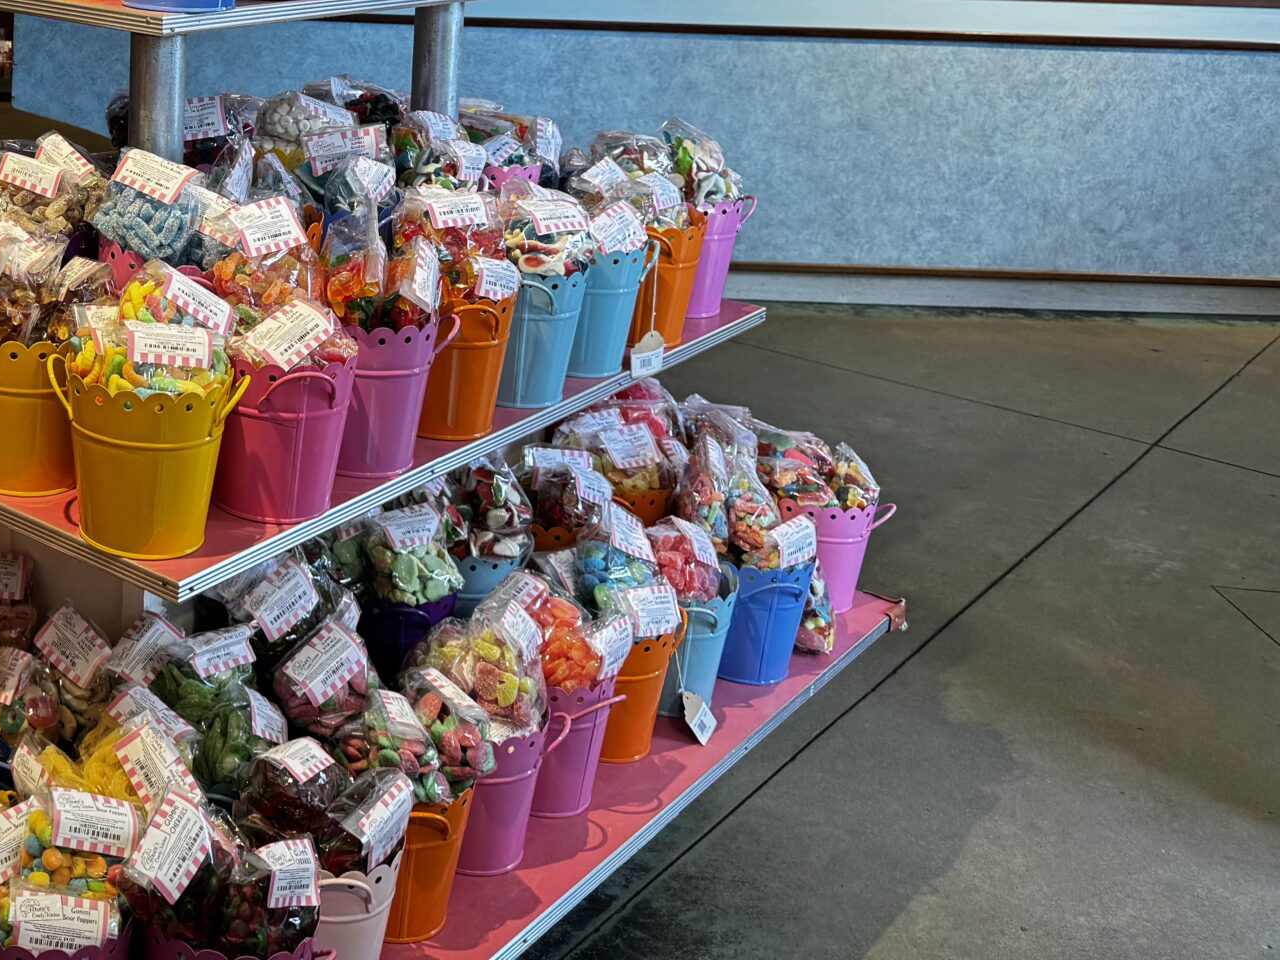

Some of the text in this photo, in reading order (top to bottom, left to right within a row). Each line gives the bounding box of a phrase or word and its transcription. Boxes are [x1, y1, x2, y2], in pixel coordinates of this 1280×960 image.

[164, 805, 180, 827] GUMMI
[170, 807, 188, 834] CHERRIES
[71, 907, 91, 916] Gummi
[76, 916, 98, 925] Poppers
